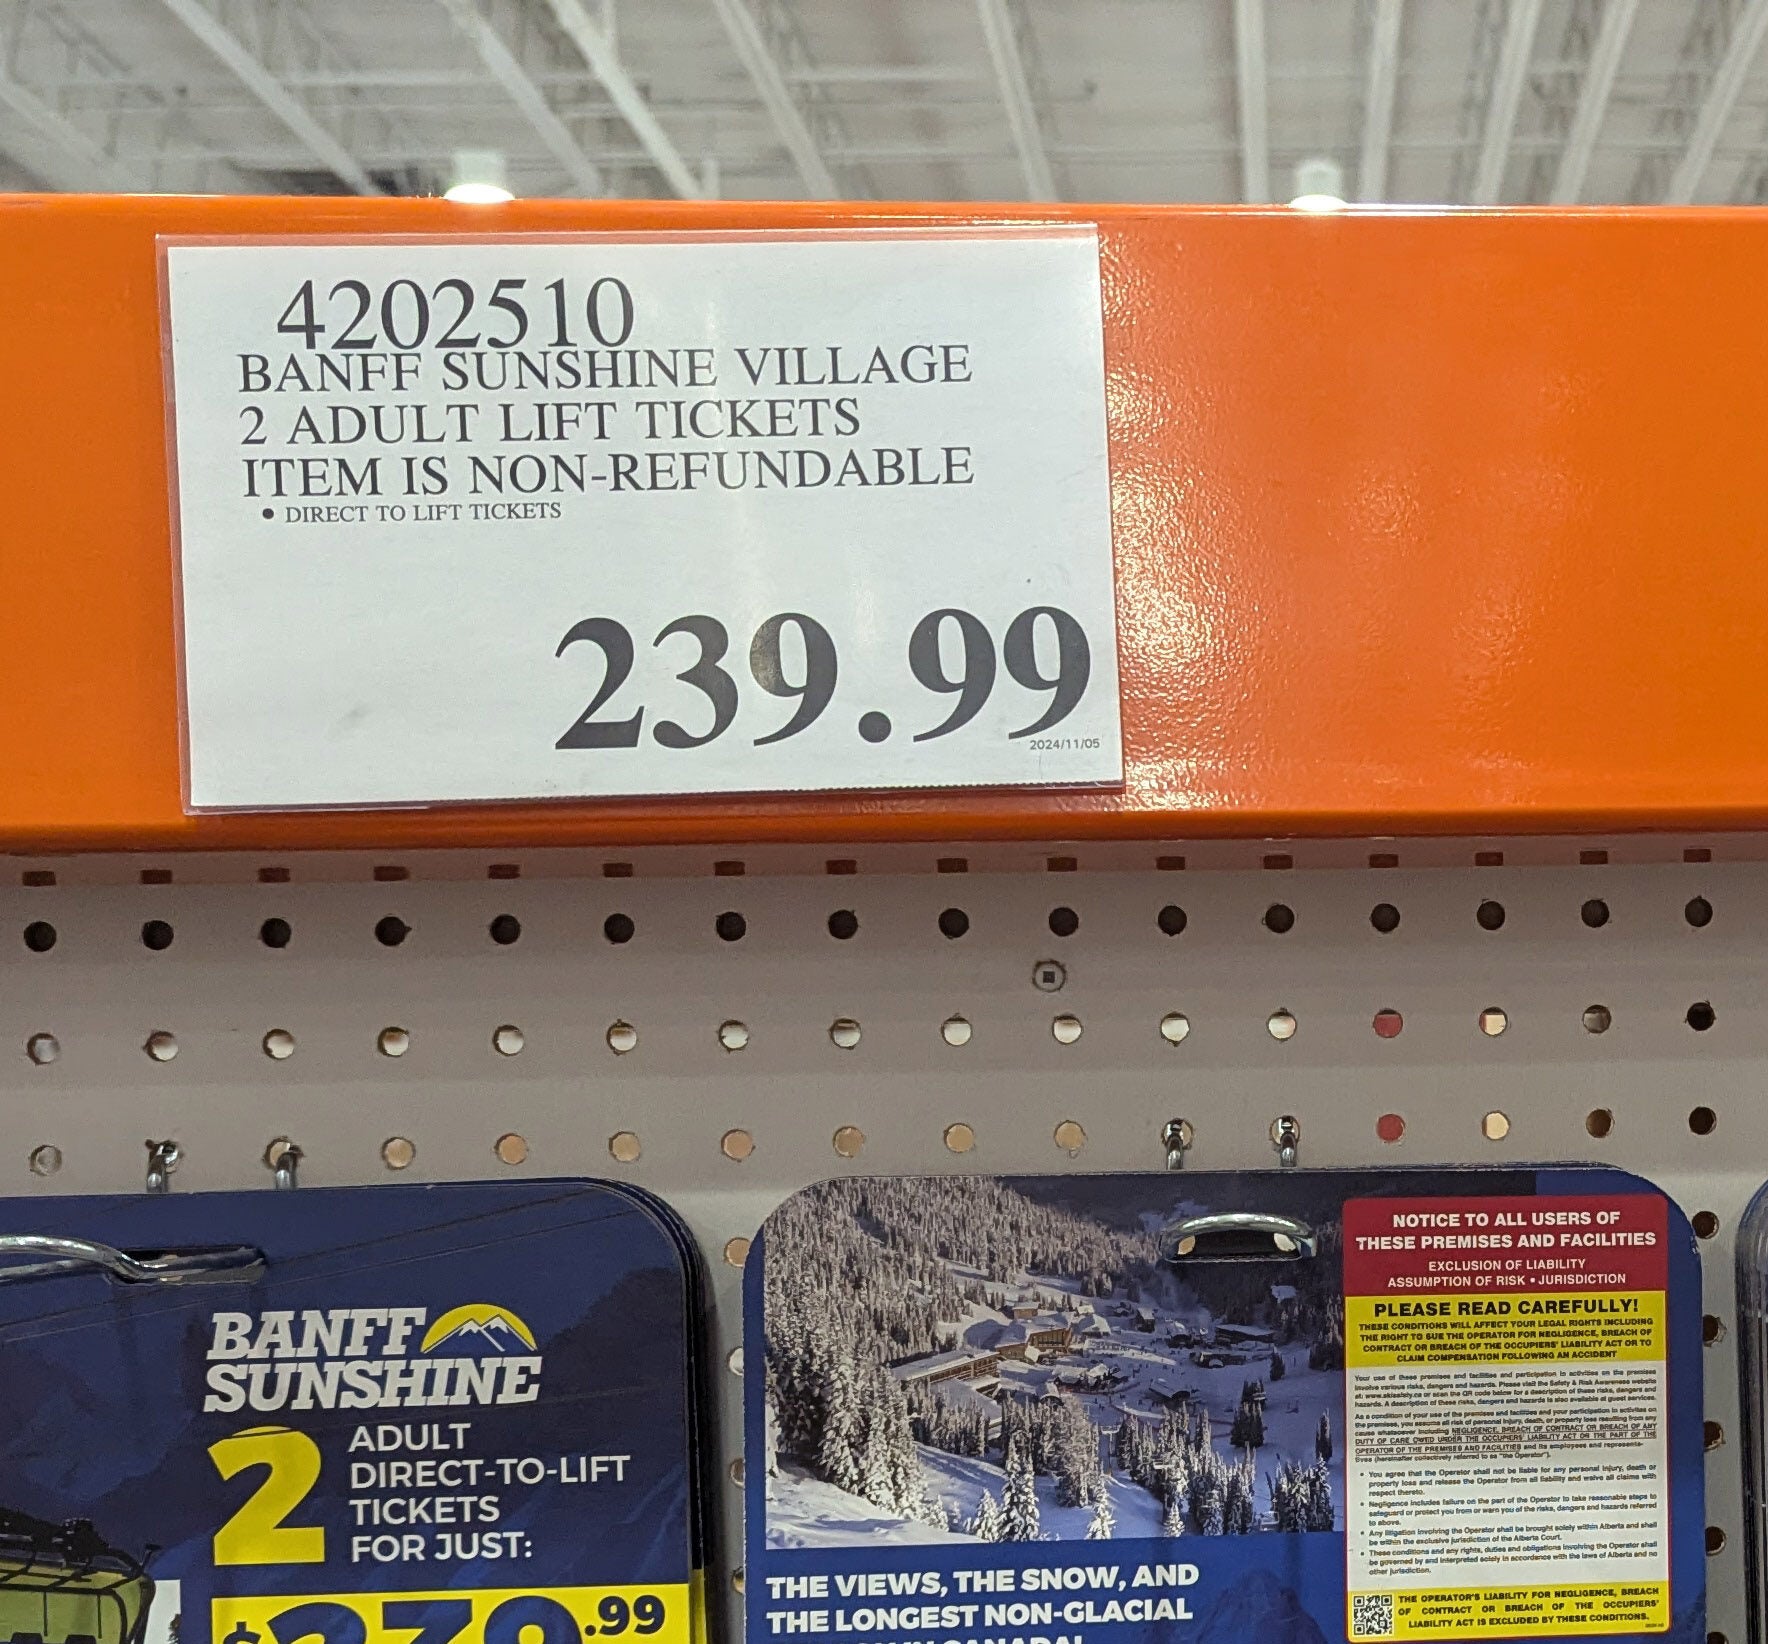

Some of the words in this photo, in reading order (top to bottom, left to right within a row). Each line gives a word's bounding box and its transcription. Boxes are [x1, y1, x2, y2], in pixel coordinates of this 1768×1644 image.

[278, 278, 638, 354] 4202510
[237, 353, 421, 392] BANFF
[443, 349, 717, 390] SUNSHINE
[734, 345, 972, 385] VILLAGE
[240, 406, 267, 444] 2
[287, 404, 479, 444] ADULT
[499, 402, 617, 441] LIFT
[636, 398, 859, 439] TICKETS
[243, 458, 382, 497] ITEM
[401, 456, 447, 495] IS
[468, 447, 974, 493] NON-REFUNDABLE
[286, 506, 368, 522] DIRECT
[376, 505, 405, 521] TO
[413, 504, 462, 521] LIFT
[469, 502, 561, 519] TICKETS
[555, 606, 1092, 749] 239.99
[1030, 738, 1100, 750] 2024/11/05
[1394, 1214, 1460, 1227] NOTICE
[1465, 1213, 1488, 1226] TO
[1494, 1213, 1527, 1226] ALL
[1532, 1212, 1591, 1225] USERS
[1597, 1212, 1620, 1224] OF
[1356, 1236, 1415, 1250] THESE
[1422, 1235, 1512, 1248] PREMISES
[1518, 1234, 1554, 1247] AND
[1561, 1232, 1656, 1246] FACILITIES
[1429, 1260, 1501, 1271] EXCLUSION
[1506, 1260, 1522, 1270] OF
[1527, 1259, 1585, 1269] LIABILITY
[1388, 1276, 1470, 1287] ASSUMPTION
[1475, 1276, 1492, 1286] OF
[1497, 1275, 1525, 1285] RISK
[1539, 1274, 1625, 1284] JURISDICTION
[1375, 1302, 1450, 1317] PLEASE
[1458, 1302, 1511, 1315] READ
[1518, 1299, 1638, 1314] CAREFULLY!
[207, 1307, 426, 1361] BANFF
[1397, 1354, 1424, 1362] CLAIM
[1427, 1353, 1499, 1362] COMPENSATION
[1502, 1352, 1554, 1360] FOLLOWING
[1572, 1350, 1617, 1358] ACCIDENT
[204, 1356, 542, 1412] SUNSHINE
[349, 1423, 471, 1452] ADULT
[352, 1455, 630, 1488] DIRECT-TO-LIFT
[208, 1426, 325, 1565] 2
[349, 1496, 499, 1525] TICKETS
[352, 1535, 425, 1562] FOR
[435, 1532, 531, 1559] JUST:
[766, 1576, 828, 1599] THE
[835, 1572, 948, 1597] VIEWS,
[953, 1570, 1015, 1593] THE
[1021, 1566, 1126, 1591] SNOW,
[1132, 1564, 1199, 1587] AND
[1399, 1595, 1417, 1603] THE
[1421, 1594, 1480, 1602] OPERATOR'S
[1484, 1592, 1528, 1600] LIABILITY
[1532, 1591, 1550, 1599] FOR
[1555, 1590, 1617, 1598] NEGLIGENCE,
[1621, 1588, 1658, 1596] BREACH
[767, 1610, 829, 1633] THE
[836, 1605, 979, 1631] LONGEST
[985, 1598, 1193, 1626] NON-GLACIAL
[1409, 1619, 1453, 1628] LIABILITY
[1477, 1618, 1486, 1626] IS
[1489, 1617, 1539, 1625] EXCLUDED
[1556, 1615, 1587, 1623] THESE
[1590, 1613, 1649, 1621] CONDITIONS.
[1422, 1606, 1472, 1614] CONTRACT
[1482, 1604, 1495, 1612] OR
[1505, 1603, 1542, 1612] BREACH
[1603, 1600, 1659, 1609] OCCUPIERS'
